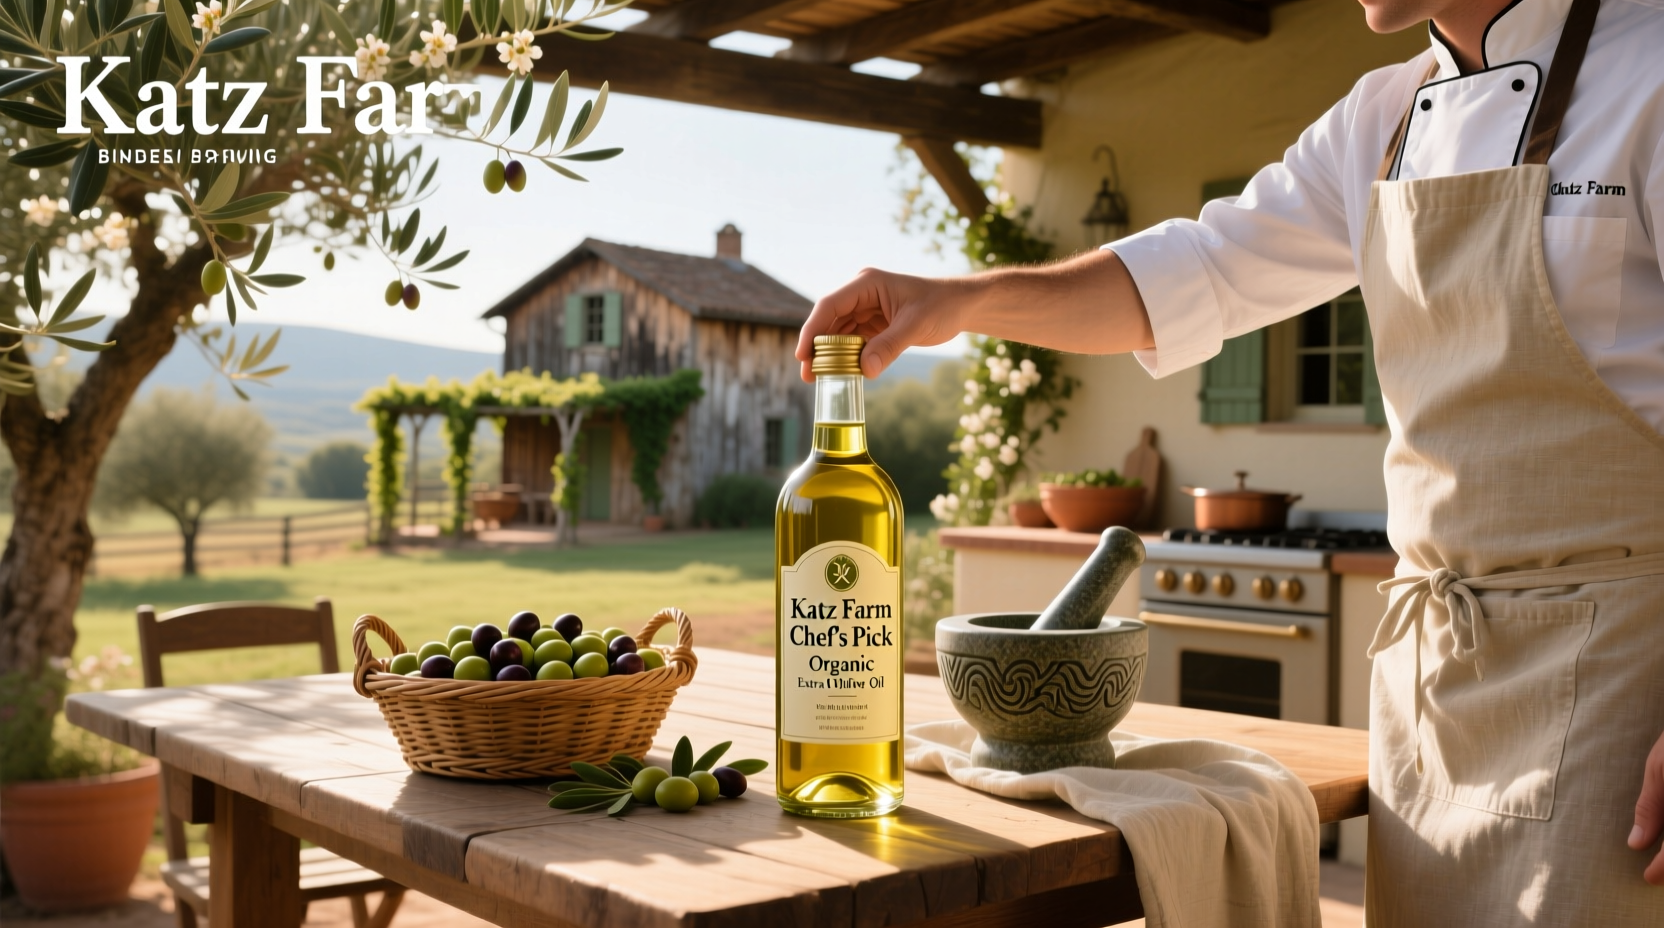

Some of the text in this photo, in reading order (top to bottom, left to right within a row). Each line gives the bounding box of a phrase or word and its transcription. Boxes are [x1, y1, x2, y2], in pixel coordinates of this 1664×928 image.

[1586, 181, 1626, 196] Farm
[790, 598, 892, 620] Katz Farm
[790, 625, 893, 647] Chef's Pick
[809, 655, 875, 676] Organic
[797, 677, 824, 689] Extra
[869, 676, 884, 689] Oil
